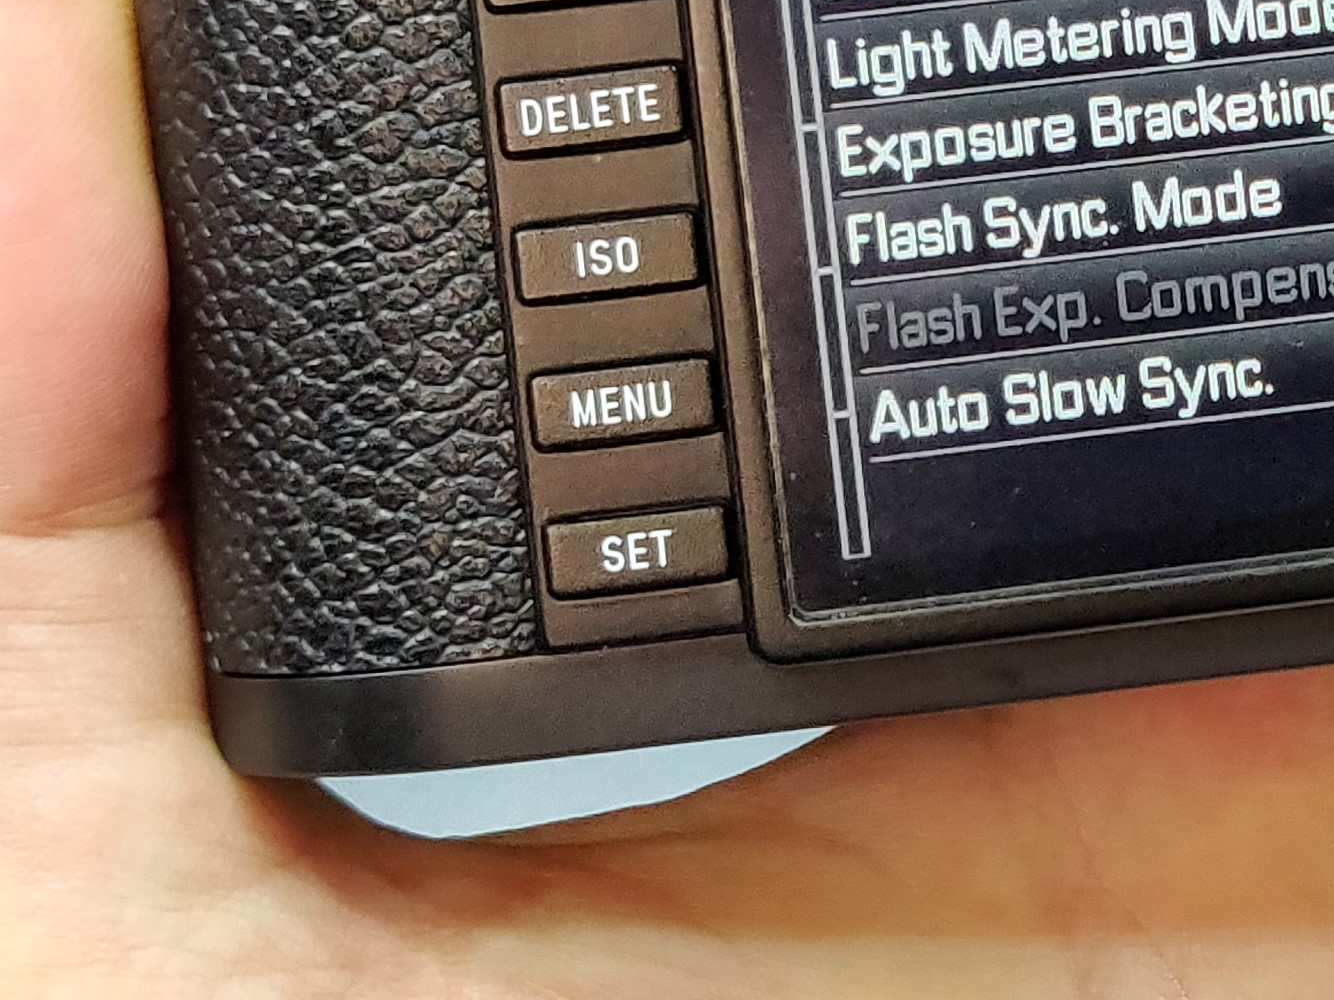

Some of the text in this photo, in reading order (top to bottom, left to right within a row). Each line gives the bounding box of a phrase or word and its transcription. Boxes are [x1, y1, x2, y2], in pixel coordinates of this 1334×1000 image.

[827, 31, 954, 97] Light
[965, 8, 1195, 74] Metering
[519, 85, 661, 137] DELETE
[837, 112, 1075, 183] Exposure
[847, 171, 1282, 265] Flash Sync. Mode
[574, 236, 640, 278] ISO
[859, 294, 981, 353] Flash
[996, 287, 1102, 342] Exp.
[570, 379, 673, 429] MENU
[870, 357, 1274, 444] Auto Slow Sync.
[601, 530, 673, 572] SET
